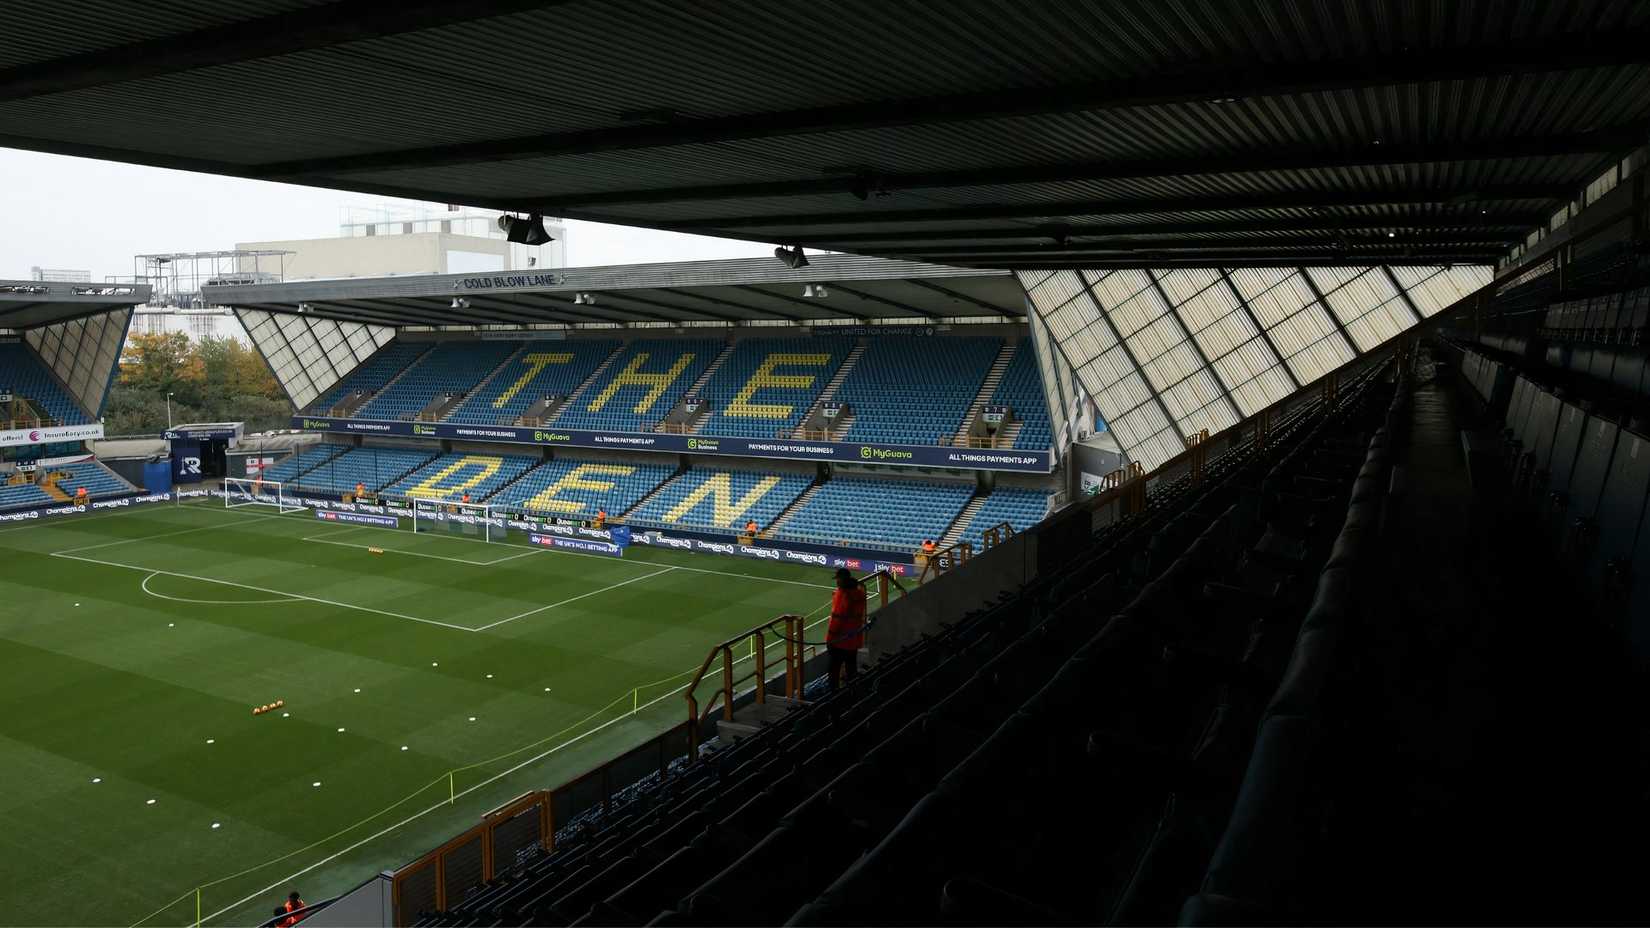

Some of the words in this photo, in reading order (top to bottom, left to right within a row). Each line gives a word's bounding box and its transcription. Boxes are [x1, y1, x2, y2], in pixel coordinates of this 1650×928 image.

[464, 278, 492, 289] COLD
[494, 276, 526, 288] BLOW
[527, 274, 556, 286] LANE
[492, 353, 832, 418] THE
[543, 433, 570, 441] MyGuava
[748, 443, 776, 451] PAYMENTS
[790, 445, 805, 453] YOUR
[806, 446, 833, 454] BUSINESS
[873, 448, 912, 459] MyGuava
[949, 453, 961, 461] ALL
[961, 454, 986, 462] THINGS
[986, 455, 1022, 464] PAYMENTS
[1022, 457, 1037, 465] APP
[405, 455, 780, 529] DEN
[834, 558, 846, 567] sky
[847, 560, 860, 568] bet
[878, 563, 890, 572] sky
[891, 565, 904, 574] bet
